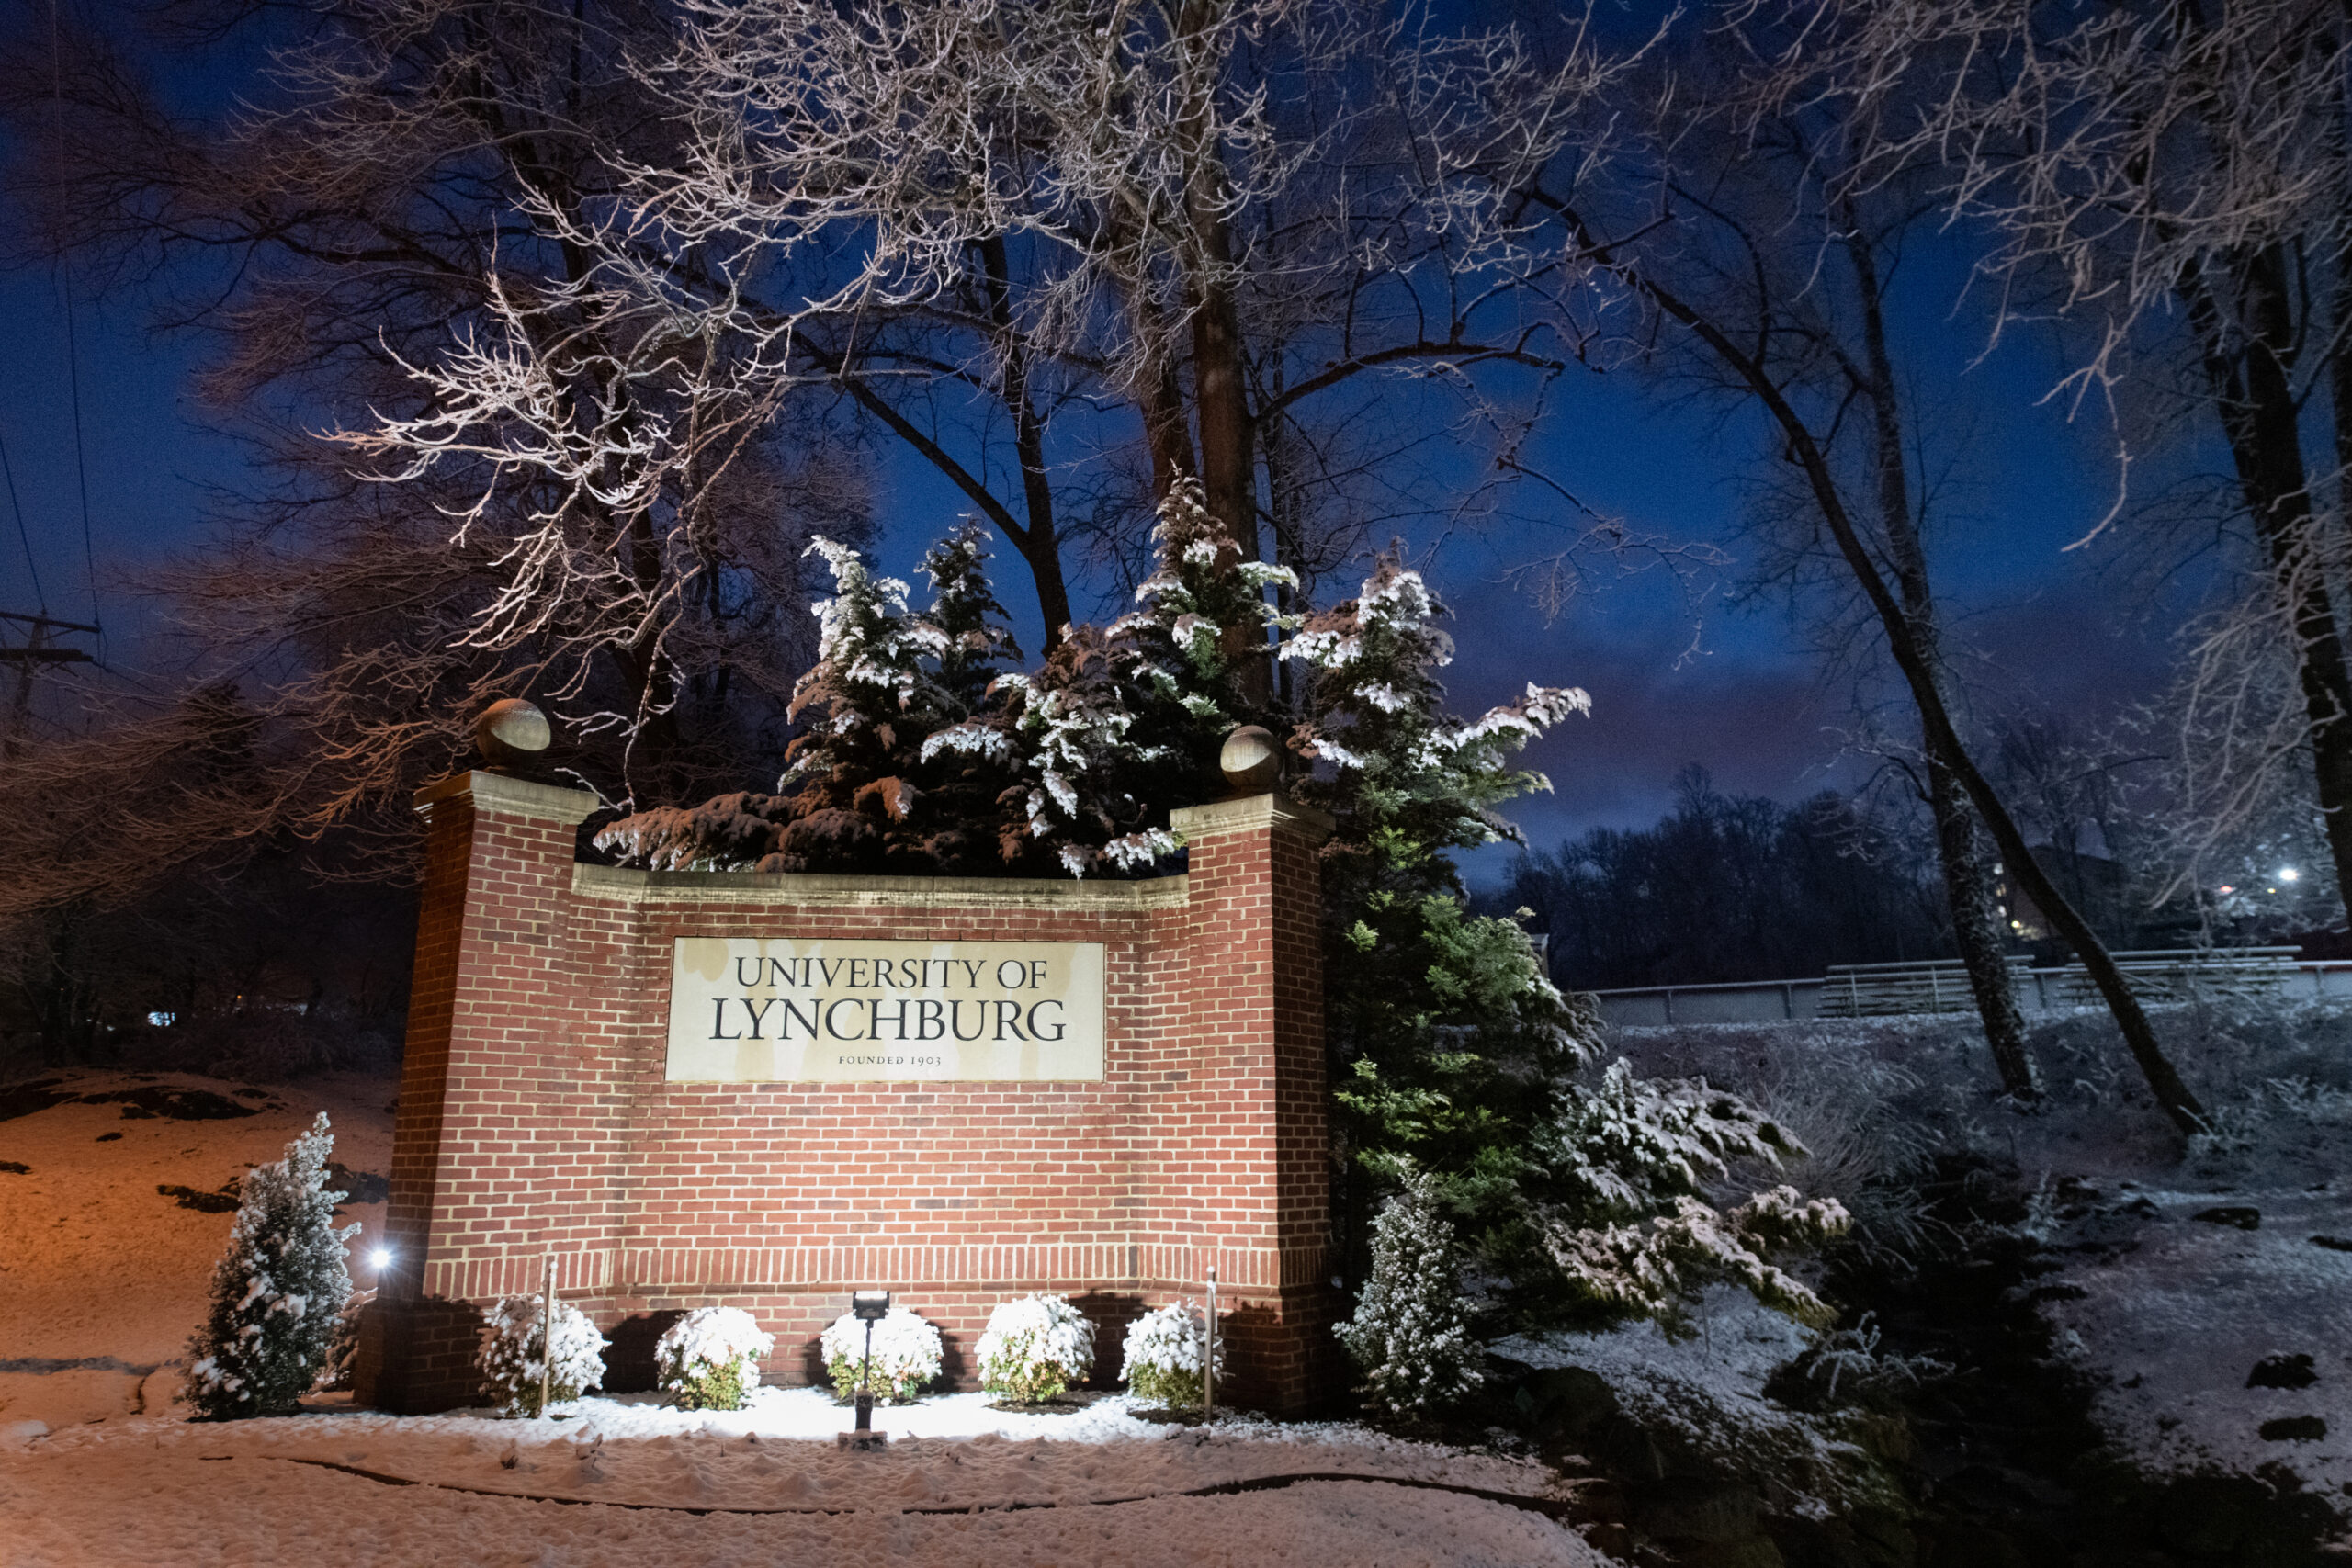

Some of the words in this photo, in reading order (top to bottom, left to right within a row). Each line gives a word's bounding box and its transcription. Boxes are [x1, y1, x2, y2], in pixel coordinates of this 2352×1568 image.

[735, 956, 987, 988] UNIVERSITY
[997, 959, 1047, 989] OF
[708, 998, 1067, 1042] LYNCHBURG
[839, 1056, 905, 1065] FOUNDED
[910, 1056, 942, 1067] 1903
